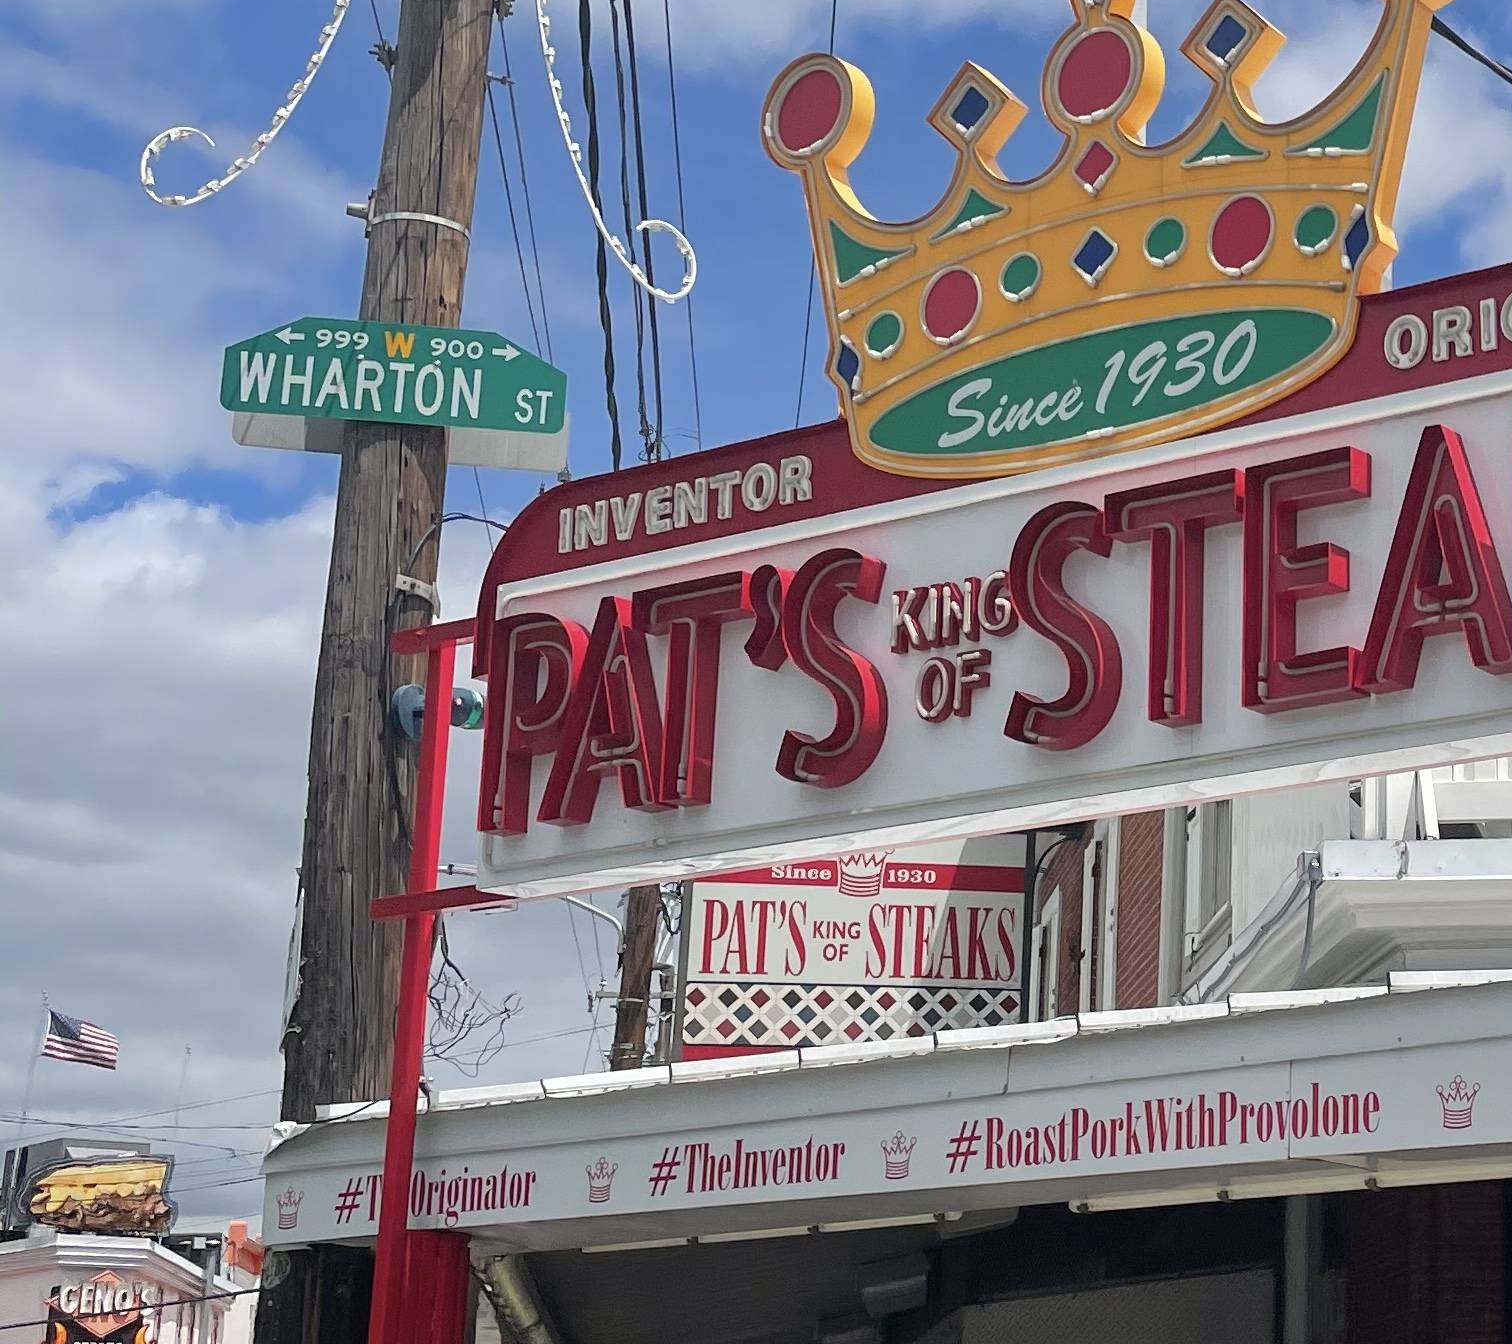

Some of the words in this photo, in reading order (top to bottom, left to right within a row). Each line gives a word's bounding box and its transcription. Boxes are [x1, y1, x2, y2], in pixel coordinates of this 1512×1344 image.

[315, 328, 370, 351] 999
[384, 330, 416, 359] W
[430, 337, 484, 361] 900
[239, 350, 483, 420] WHARTON
[513, 387, 554, 426] ST
[938, 376, 1084, 452] Since
[1091, 316, 1259, 416] 1930
[556, 454, 814, 556] INVENTOR
[889, 566, 1013, 655] KING
[476, 549, 888, 838] PAT'S
[915, 647, 993, 724] OF
[771, 863, 833, 881] Since
[887, 867, 938, 885] 1930
[698, 898, 808, 978] PAT'S
[812, 919, 861, 941] KING
[822, 943, 850, 962] OF
[864, 902, 1017, 982] STEAKS
[648, 1133, 847, 1198] #TheInventor
[945, 1081, 1381, 1175] #RoastPorkWithProvolone
[334, 1162, 538, 1227] #TOriginator
[59, 1278, 158, 1316] GENO'S
